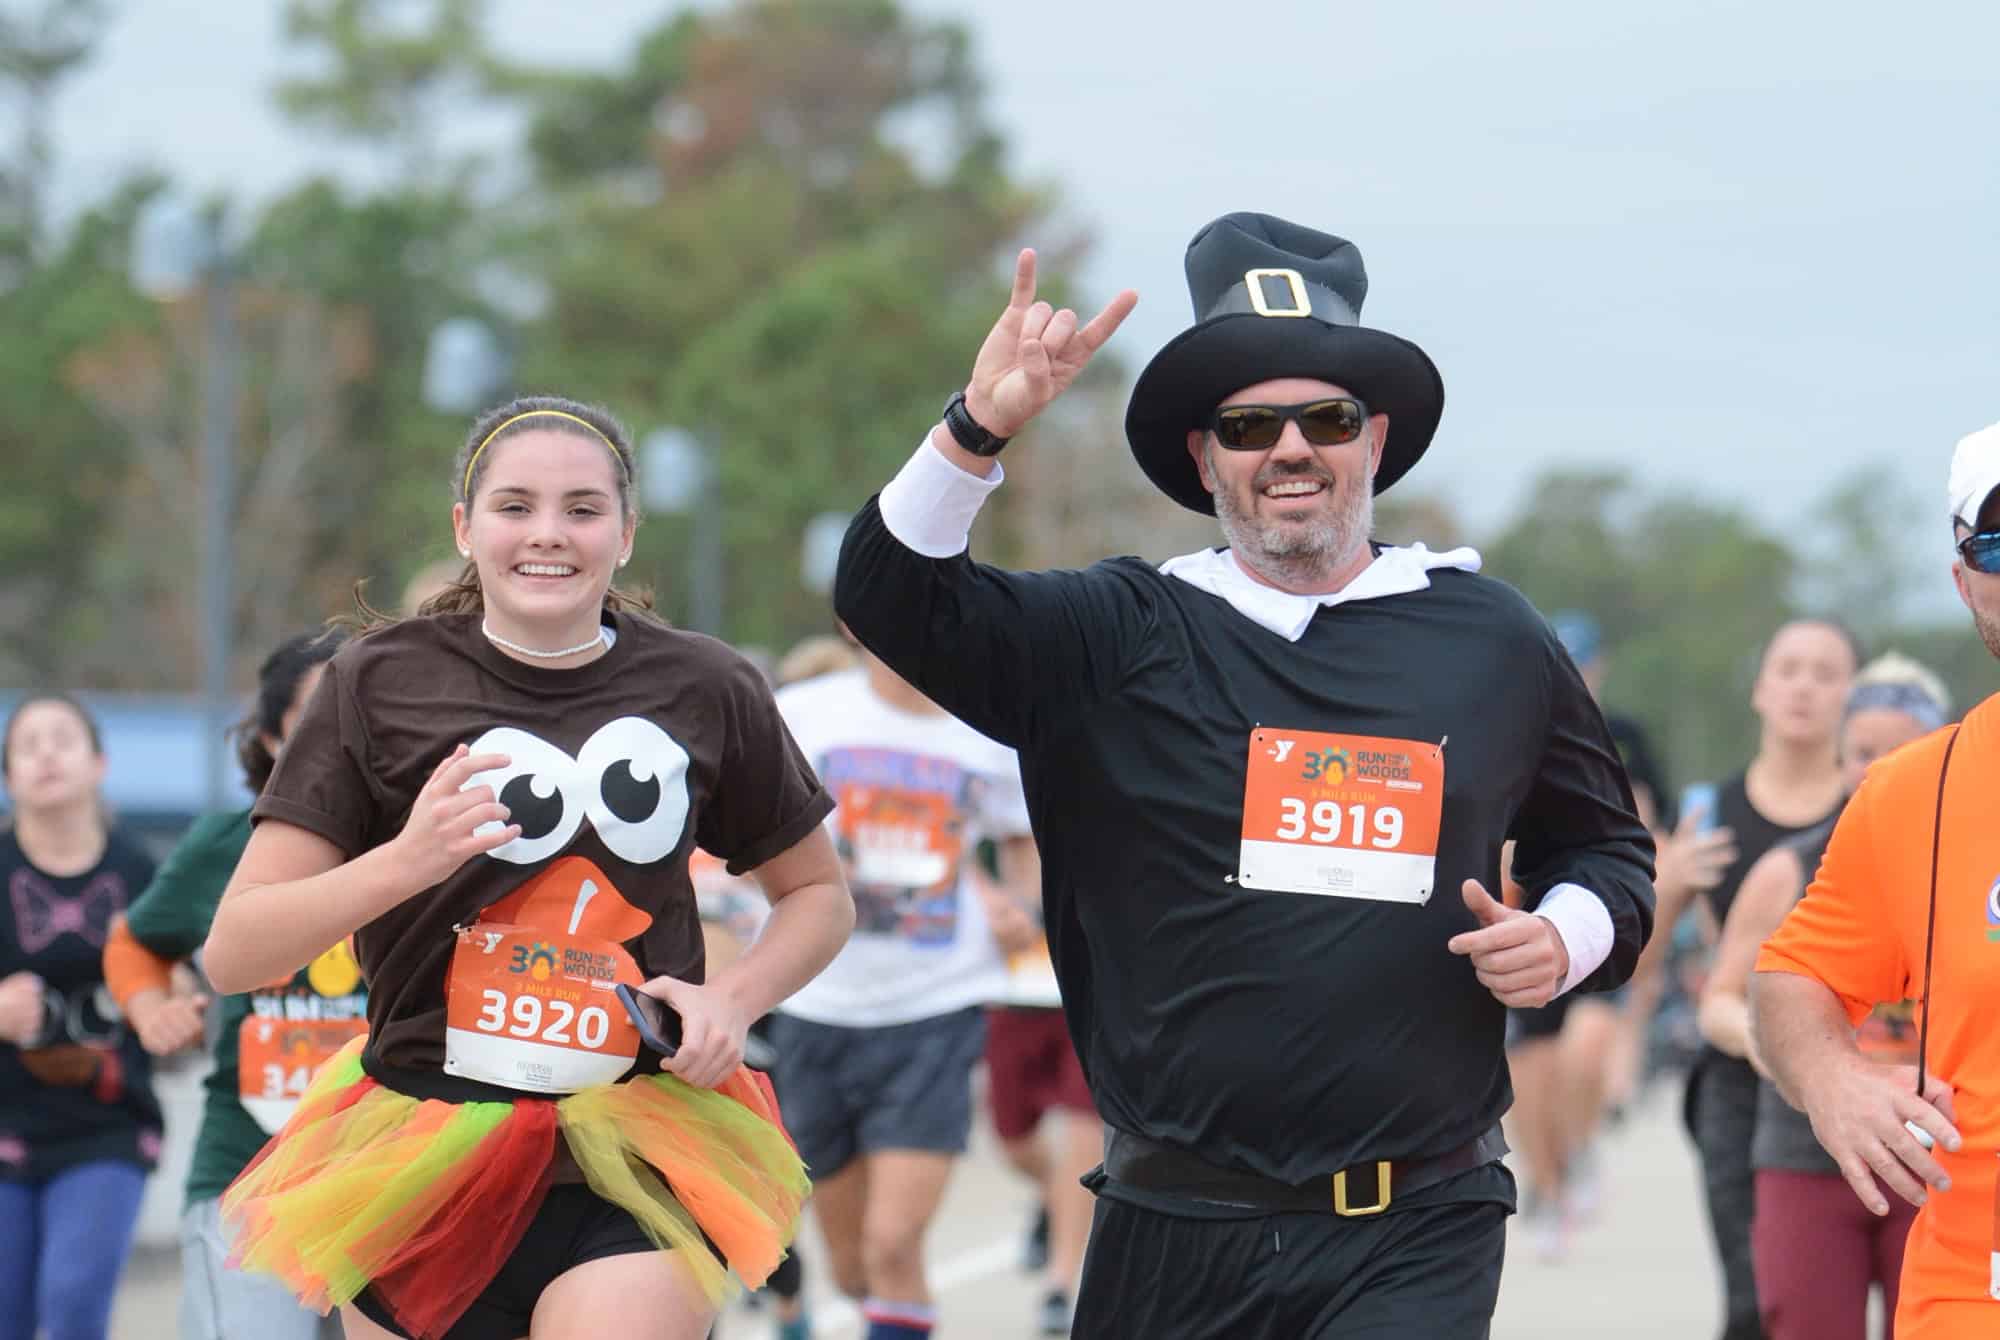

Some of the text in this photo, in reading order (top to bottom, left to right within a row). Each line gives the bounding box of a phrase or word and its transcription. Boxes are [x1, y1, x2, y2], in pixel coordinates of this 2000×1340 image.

[1357, 751, 1386, 765] RUN
[1357, 764, 1410, 780] WOODS
[1276, 797, 1403, 849] 3919
[564, 948, 592, 963] RUN
[564, 963, 616, 981] WOODS
[476, 989, 609, 1049] 3920
[263, 1064, 318, 1097] 34
